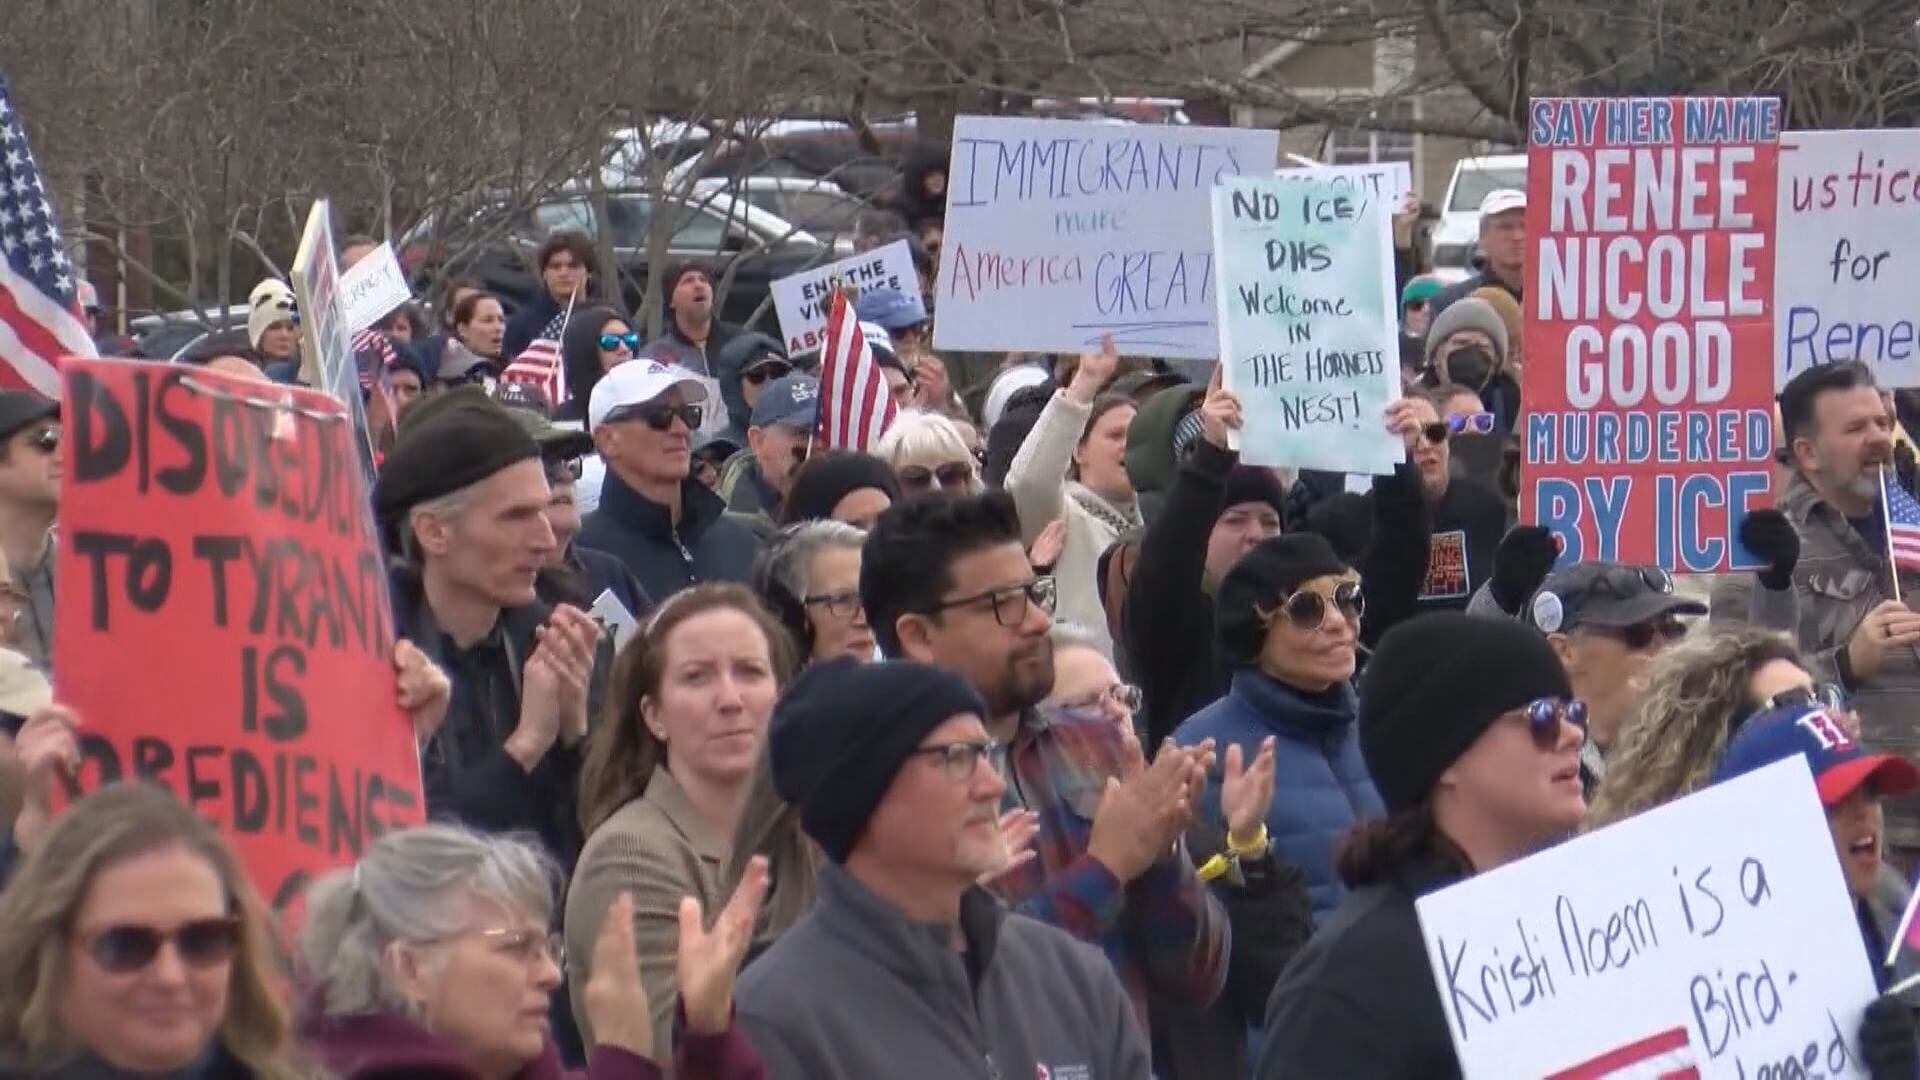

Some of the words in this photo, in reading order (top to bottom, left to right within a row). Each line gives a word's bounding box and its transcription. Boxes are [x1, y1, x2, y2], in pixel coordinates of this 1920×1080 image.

[1533, 100, 1600, 146] SAY
[1605, 98, 1674, 144] HER
[1684, 97, 1781, 143] NAME
[1231, 191, 1279, 222] NO
[1550, 148, 1755, 232] RENEE
[1780, 146, 1920, 212] ustic
[845, 259, 885, 284] THE
[951, 243, 1082, 301] America
[1096, 250, 1214, 316] GREAT
[1265, 238, 1332, 274] DHS
[1538, 233, 1765, 320] NICOLE
[1830, 237, 1890, 283] for
[1239, 281, 1353, 317] Welcome
[1288, 322, 1311, 344] IN
[1786, 306, 1920, 374] Rene
[1242, 353, 1293, 388] THE
[1566, 321, 1731, 410] GOOD
[1280, 390, 1360, 431] NEST!
[1527, 409, 1772, 464] MURDERED
[1536, 475, 1632, 573] BY
[1656, 471, 1770, 573] ICE
[74, 532, 172, 632] TO
[242, 646, 307, 742] IS
[1438, 917, 1555, 1041] Kristi
[1556, 895, 1658, 976] Noem
[1673, 866, 1724, 938] is
[1740, 857, 1771, 906] a
